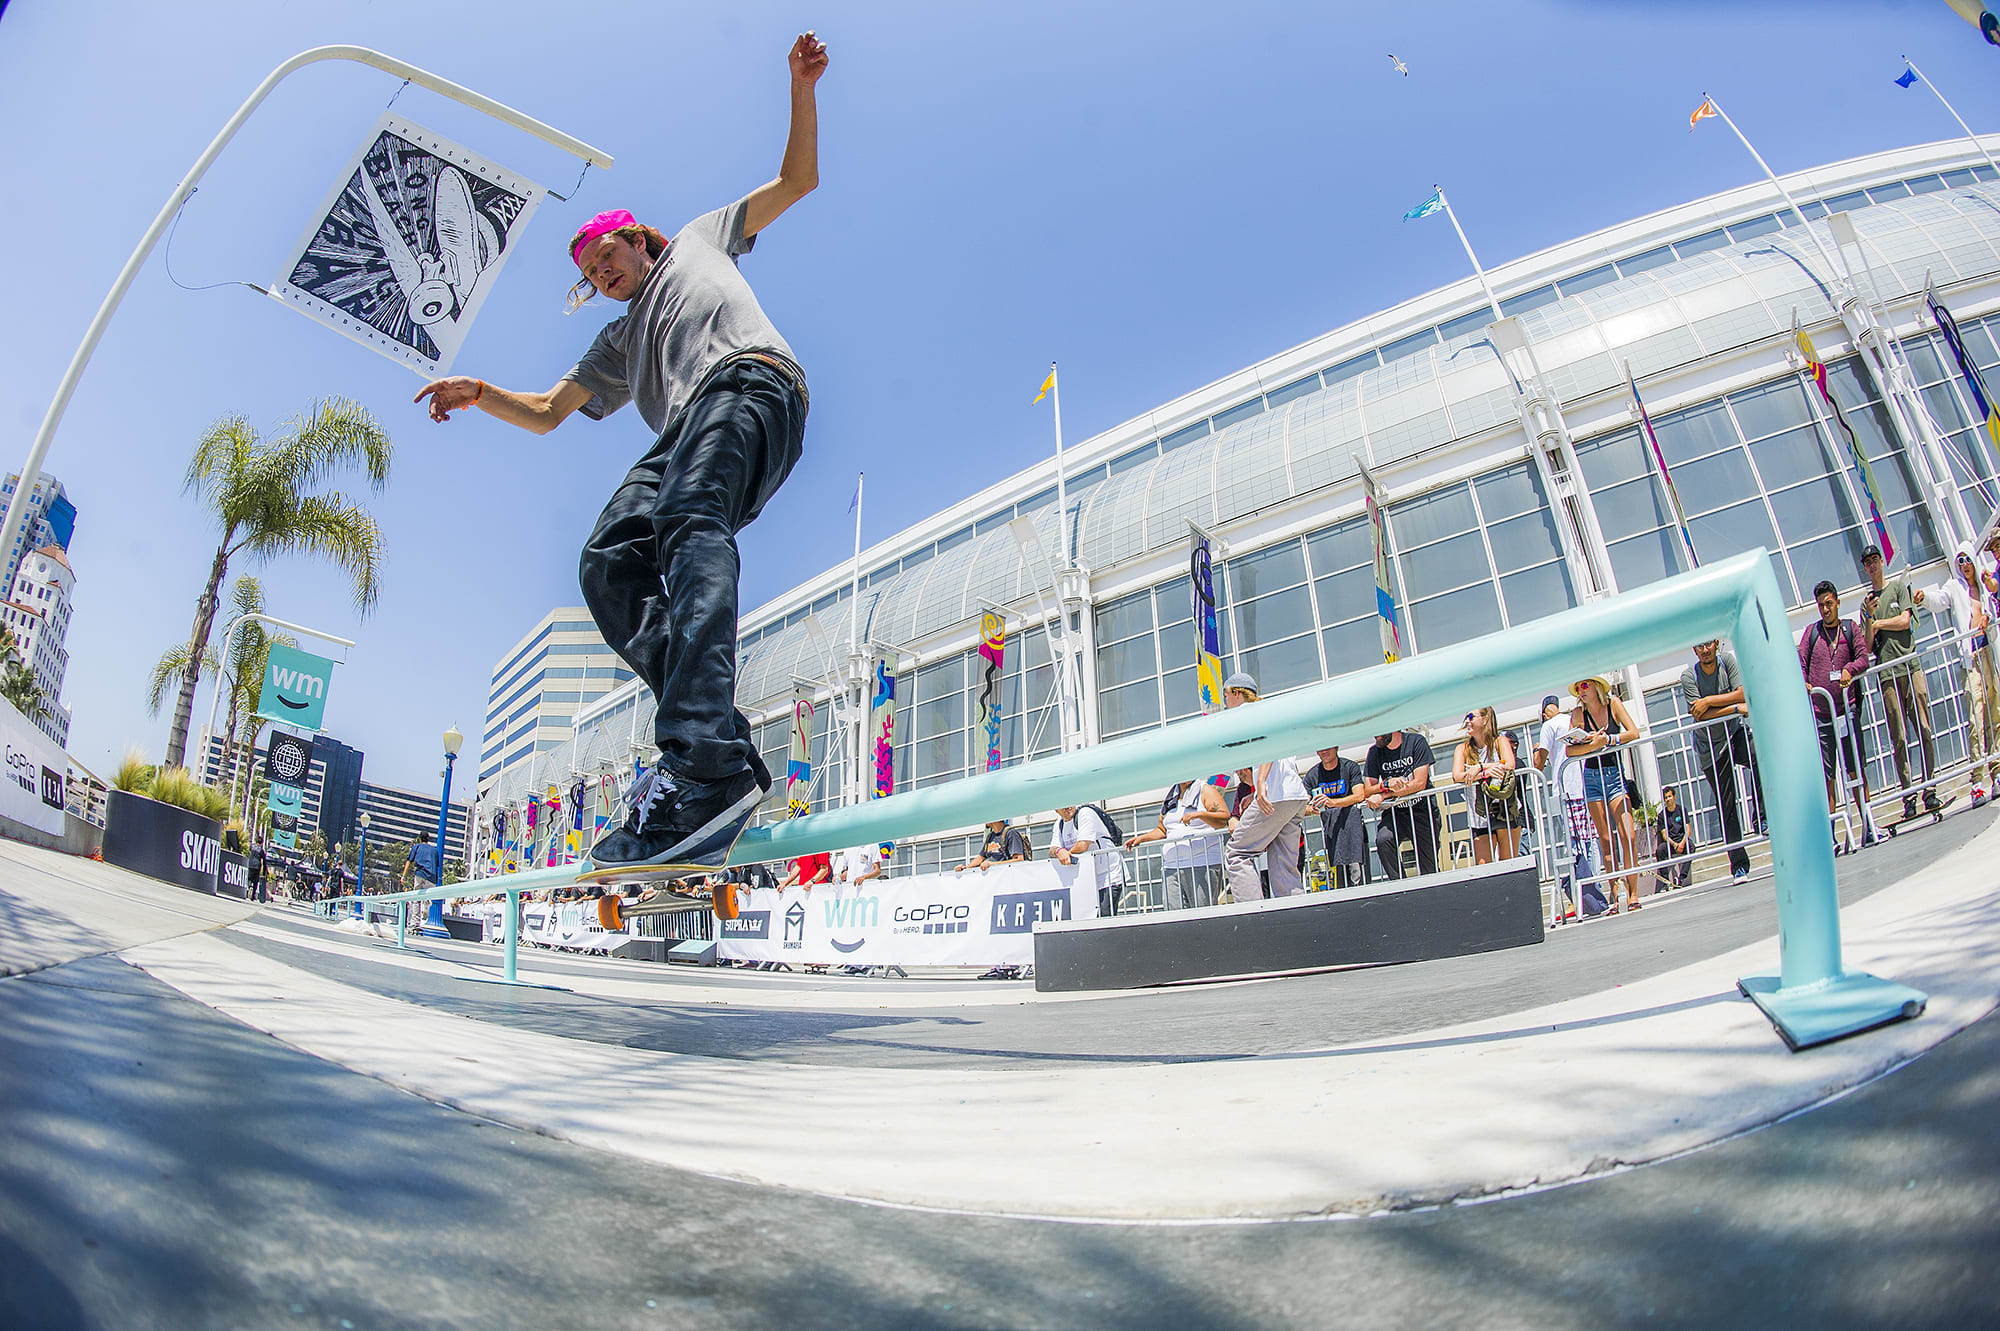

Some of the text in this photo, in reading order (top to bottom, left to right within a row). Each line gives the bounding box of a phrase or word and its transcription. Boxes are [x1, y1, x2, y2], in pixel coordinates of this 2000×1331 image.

[387, 120, 534, 197] TRANSWORLD
[361, 152, 419, 248] BEACH
[397, 147, 442, 230] LONG
[281, 287, 436, 372] SKATEBOARDING
[272, 664, 324, 699] wm
[6, 744, 35, 779] GoPro
[1382, 756, 1414, 771] CASINO
[274, 783, 300, 800] wm
[725, 919, 749, 932] SUPRA
[824, 895, 879, 928] wm
[894, 904, 970, 922] GoPro
